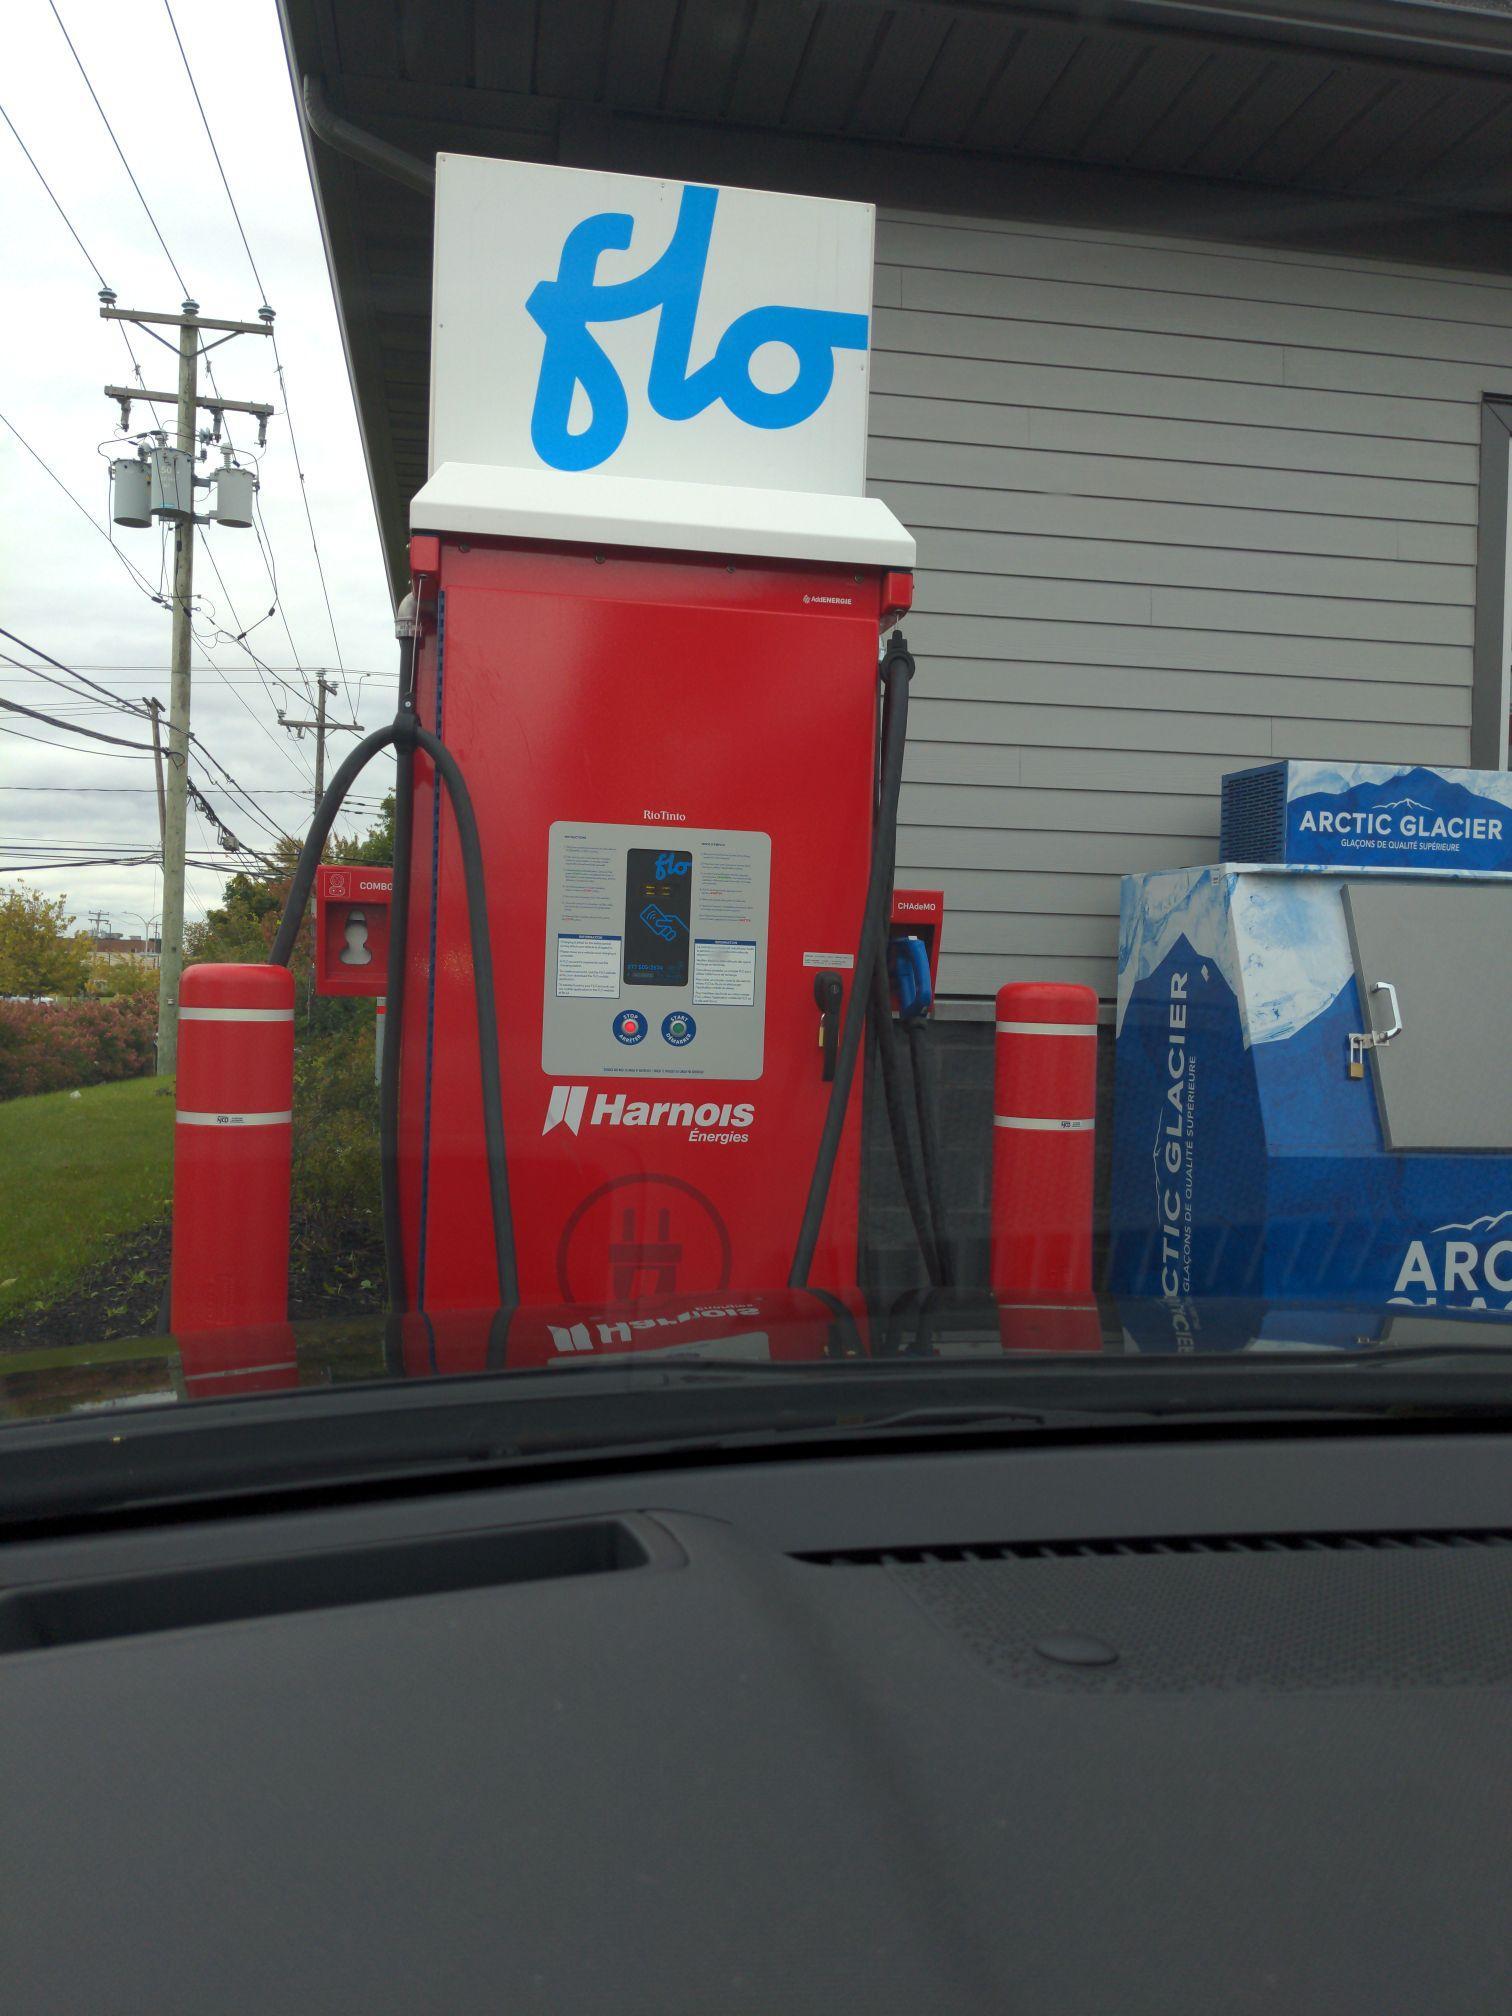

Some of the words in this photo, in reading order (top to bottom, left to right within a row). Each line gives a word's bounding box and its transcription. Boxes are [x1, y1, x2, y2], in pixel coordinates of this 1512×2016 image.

[525, 185, 868, 471] flo
[1299, 811, 1392, 835] ARCTIC
[1400, 815, 1503, 840] GLACIER
[1341, 838, 1375, 849] GLAÇONS
[1377, 840, 1388, 849] DE
[1388, 840, 1418, 850] QUALITÉ
[1419, 841, 1460, 852] SUPÉRIEURE
[655, 853, 692, 880] flo
[898, 902, 936, 911] CHAdeMO
[1165, 971, 1189, 1173] GLACIER
[591, 1093, 755, 1127] Harnois
[689, 1128, 749, 1144] Énergies
[1184, 1204, 1192, 1222] DE
[1182, 1227, 1192, 1294] GLAÇONS
